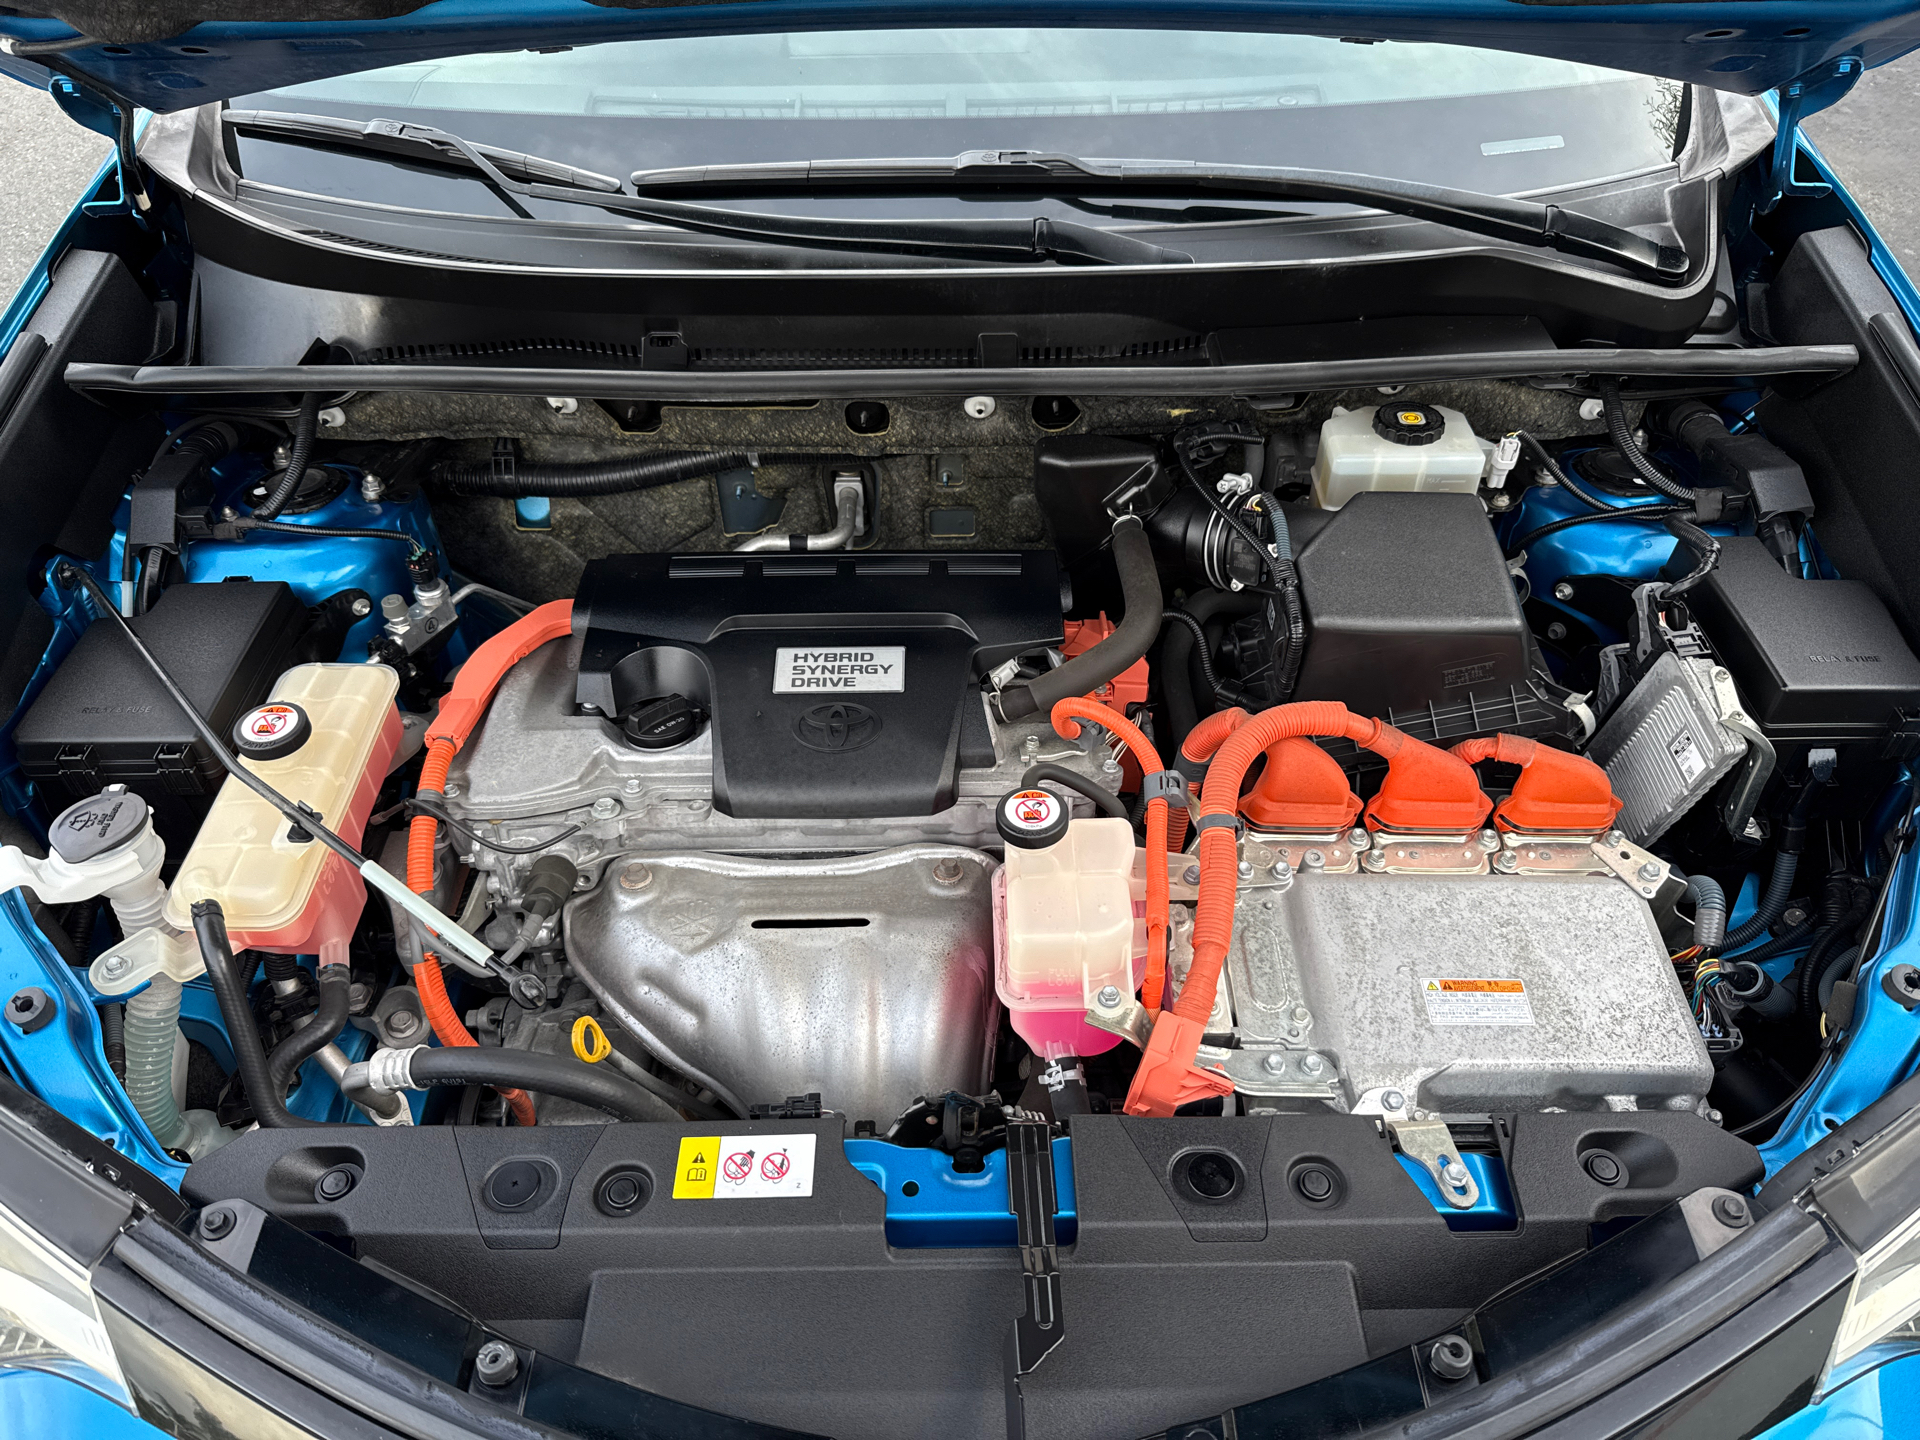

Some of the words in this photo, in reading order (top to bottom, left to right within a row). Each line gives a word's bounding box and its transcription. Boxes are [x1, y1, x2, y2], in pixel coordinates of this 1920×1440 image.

[793, 653, 874, 663] HYBRID
[792, 664, 893, 675] SYNERGY
[791, 677, 856, 688] DRIVE
[82, 706, 116, 714] RELAY
[126, 705, 153, 714] FUSE
[653, 725, 667, 734] SAE
[1048, 968, 1075, 977] FULL
[1048, 977, 1075, 987] LOW
